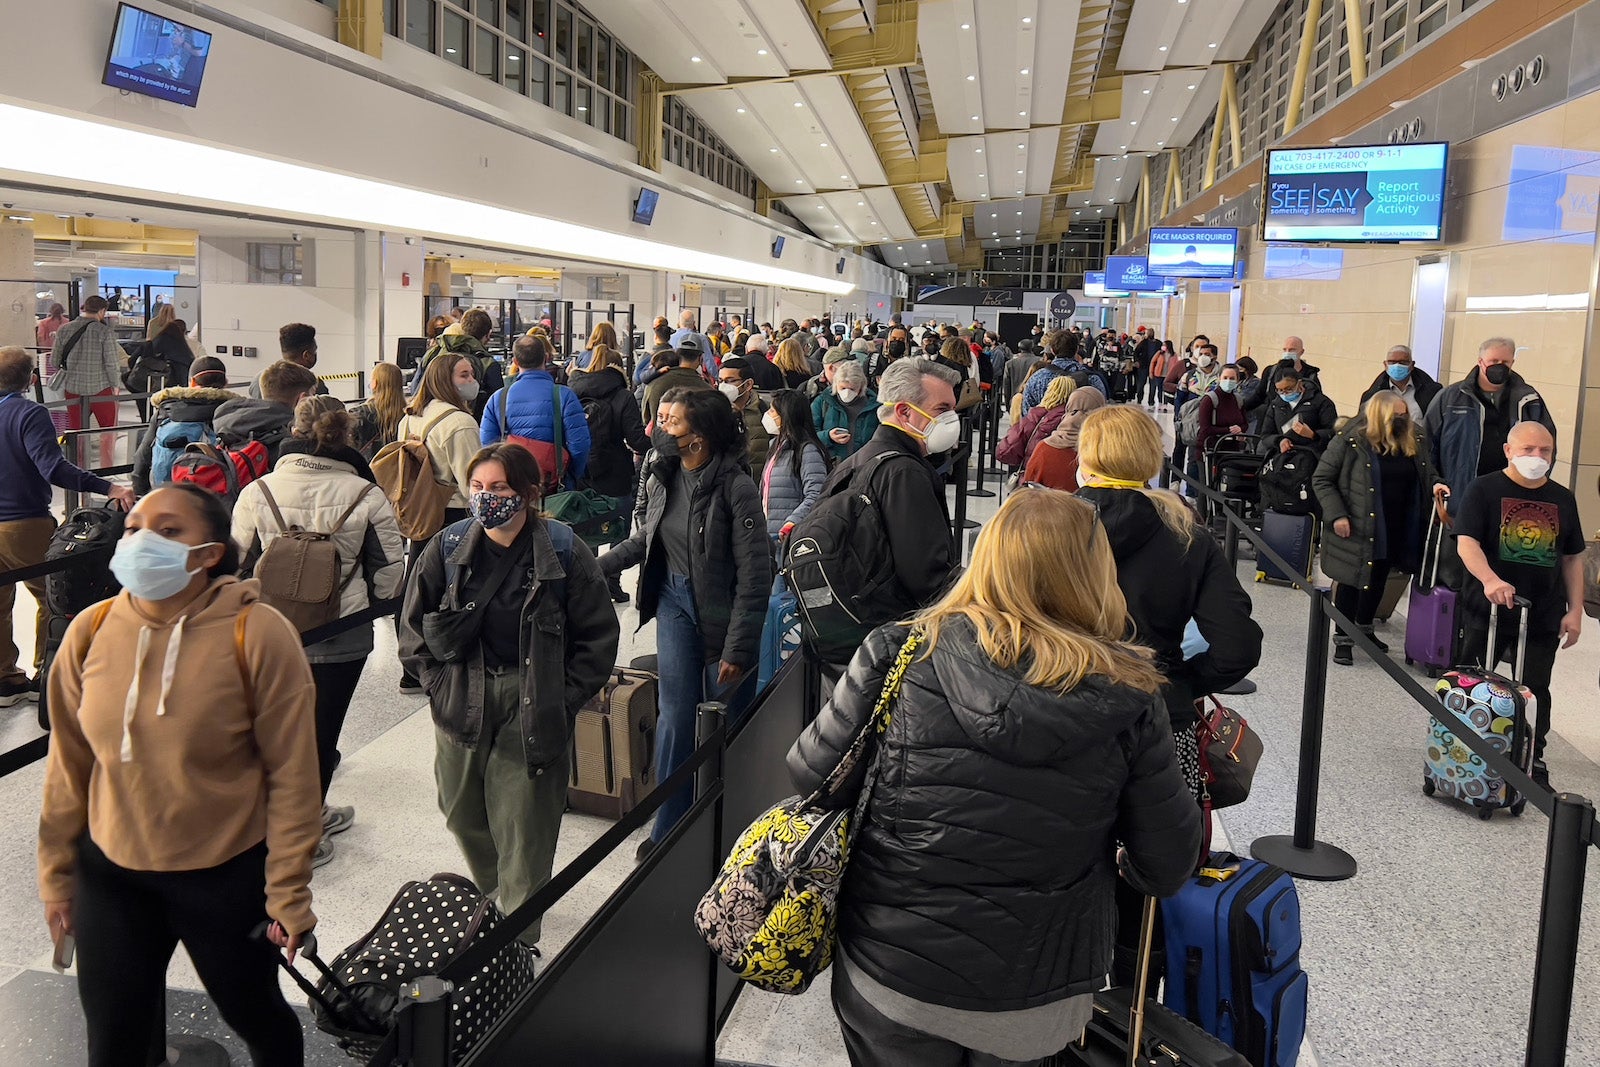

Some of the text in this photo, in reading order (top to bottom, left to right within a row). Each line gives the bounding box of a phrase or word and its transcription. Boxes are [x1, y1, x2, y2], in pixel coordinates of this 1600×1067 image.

[1296, 151, 1360, 160] 703-417-2400
[1318, 161, 1368, 170] EMERGENCY
[1378, 182, 1418, 192] Report
[1271, 188, 1360, 208] SEE SAY
[1378, 192, 1440, 204] Suspicious
[1316, 206, 1356, 214] something
[1376, 204, 1419, 216] Activity
